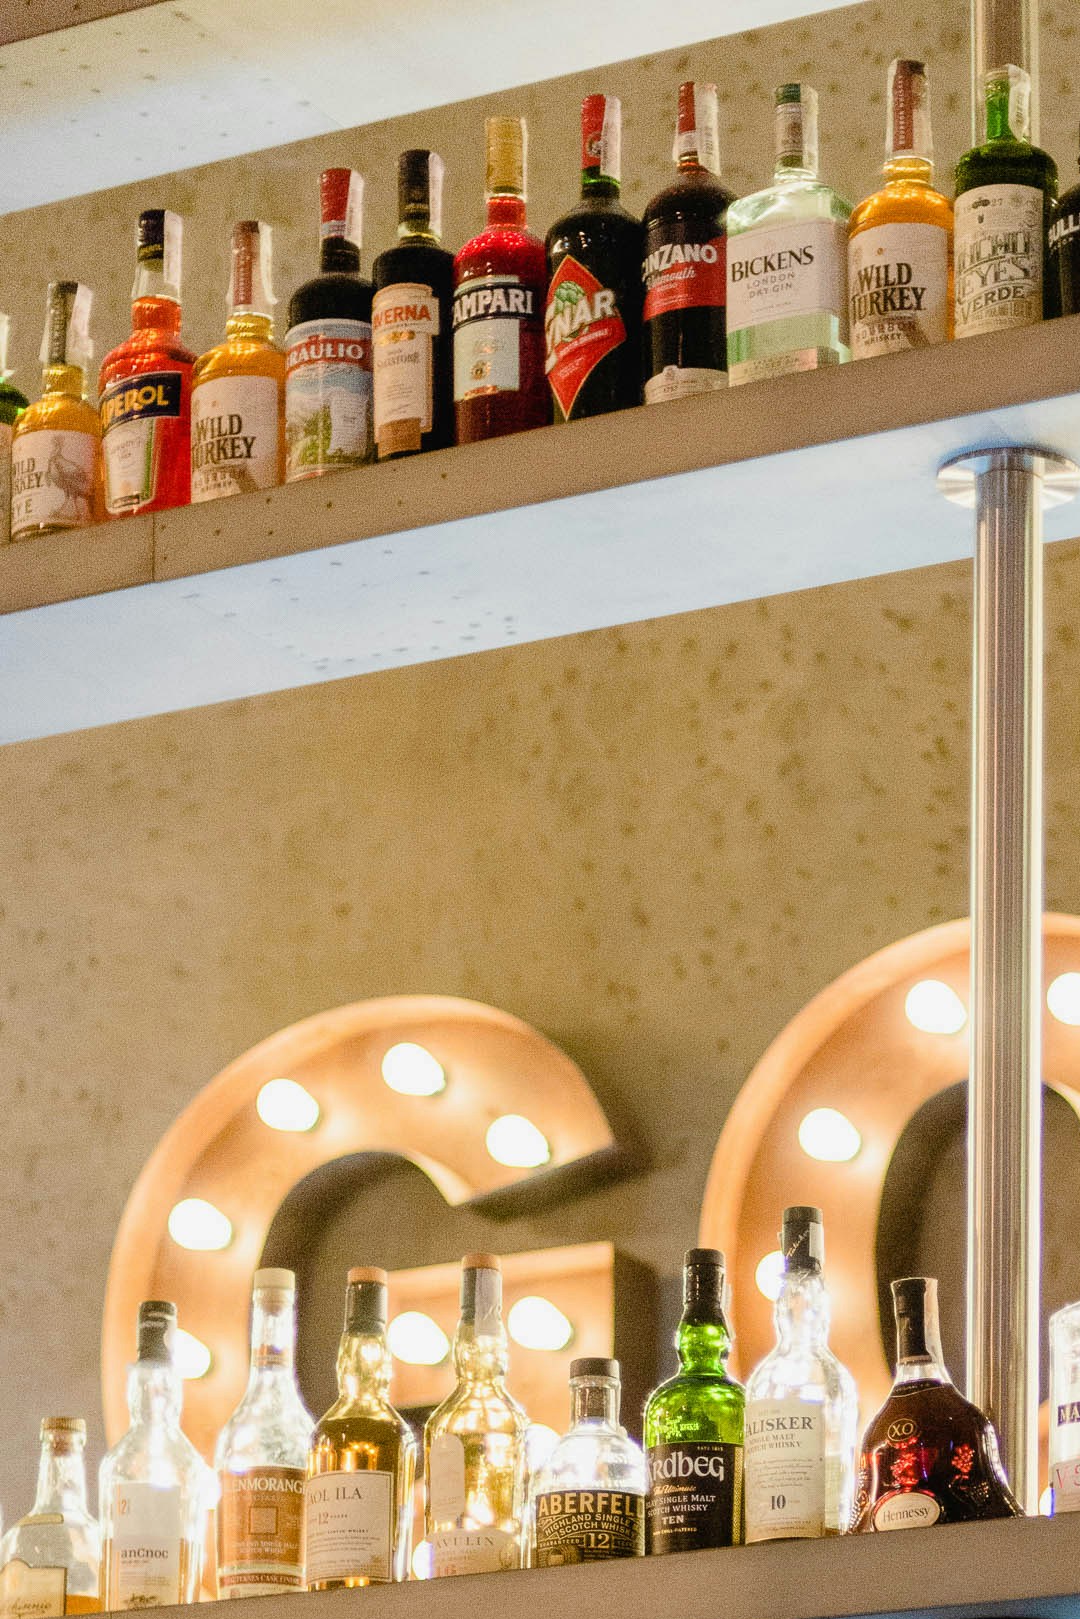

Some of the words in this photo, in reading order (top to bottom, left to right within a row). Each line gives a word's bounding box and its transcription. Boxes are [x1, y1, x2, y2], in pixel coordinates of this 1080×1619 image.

[642, 243, 717, 273] INZANO
[731, 245, 815, 283] BICKENS
[645, 265, 696, 289] mouth
[746, 271, 795, 290] LONDON
[857, 262, 912, 293] WILD
[771, 282, 793, 294] GIN
[452, 287, 533, 328] AMPARI
[850, 287, 926, 325] TURKEY
[288, 342, 364, 367] RAULIO
[195, 413, 242, 442] WILD
[12, 457, 35, 475] ILD
[891, 1421, 914, 1437] XO
[229, 1476, 305, 1496] ENMORANG
[335, 1487, 363, 1501] ILA
[691, 1494, 716, 1503] MALT
[771, 1494, 787, 1511] 10
[672, 1503, 708, 1513] WHISKY
[882, 1505, 931, 1523] Hennessy
[544, 1513, 592, 1535] HIGHLAND
[558, 1521, 598, 1537] SCOTCH
[662, 1514, 685, 1526] TEN
[435, 1535, 493, 1550] AVULIN
[588, 1532, 610, 1548] 12
